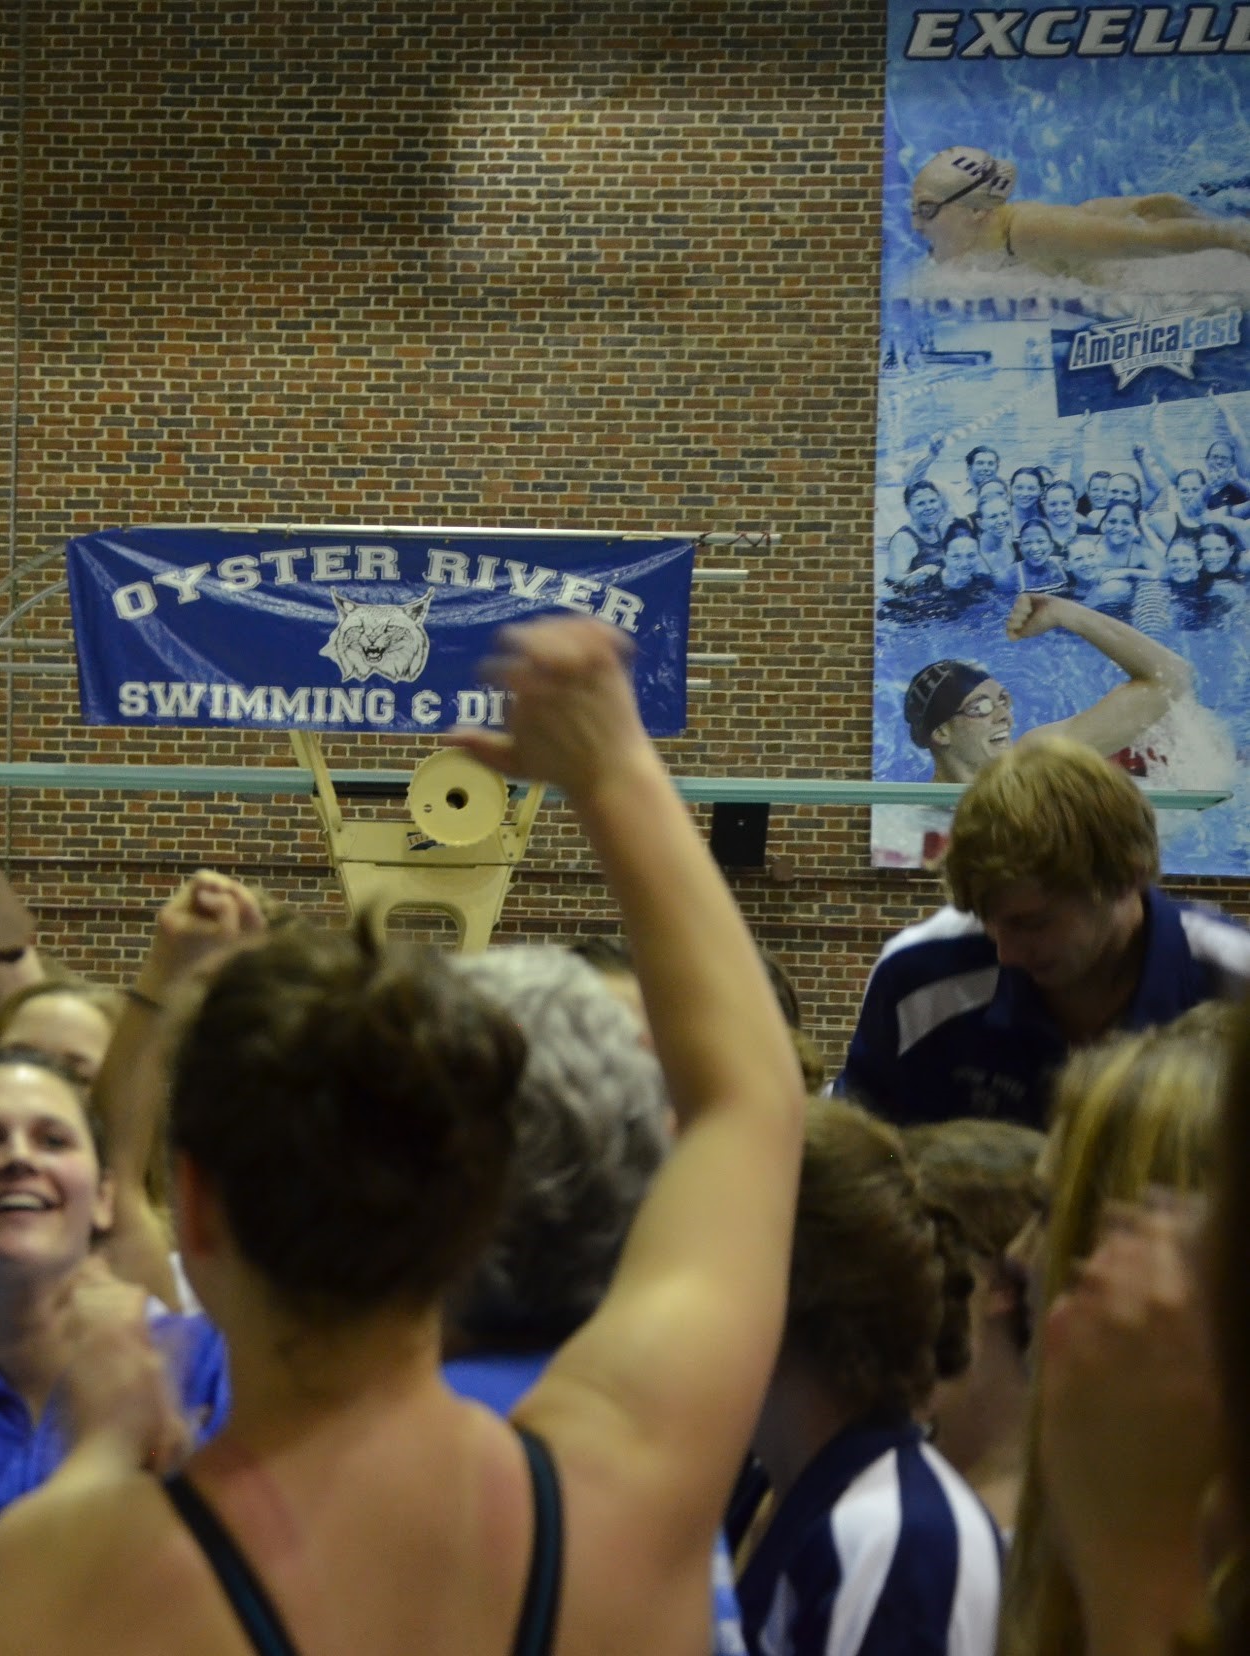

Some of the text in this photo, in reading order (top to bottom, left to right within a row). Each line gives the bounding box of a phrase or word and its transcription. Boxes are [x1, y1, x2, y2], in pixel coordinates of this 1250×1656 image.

[112, 545, 646, 633] OYSTER RIVER
[118, 681, 395, 724] SWIMMING
[411, 689, 442, 726] &
